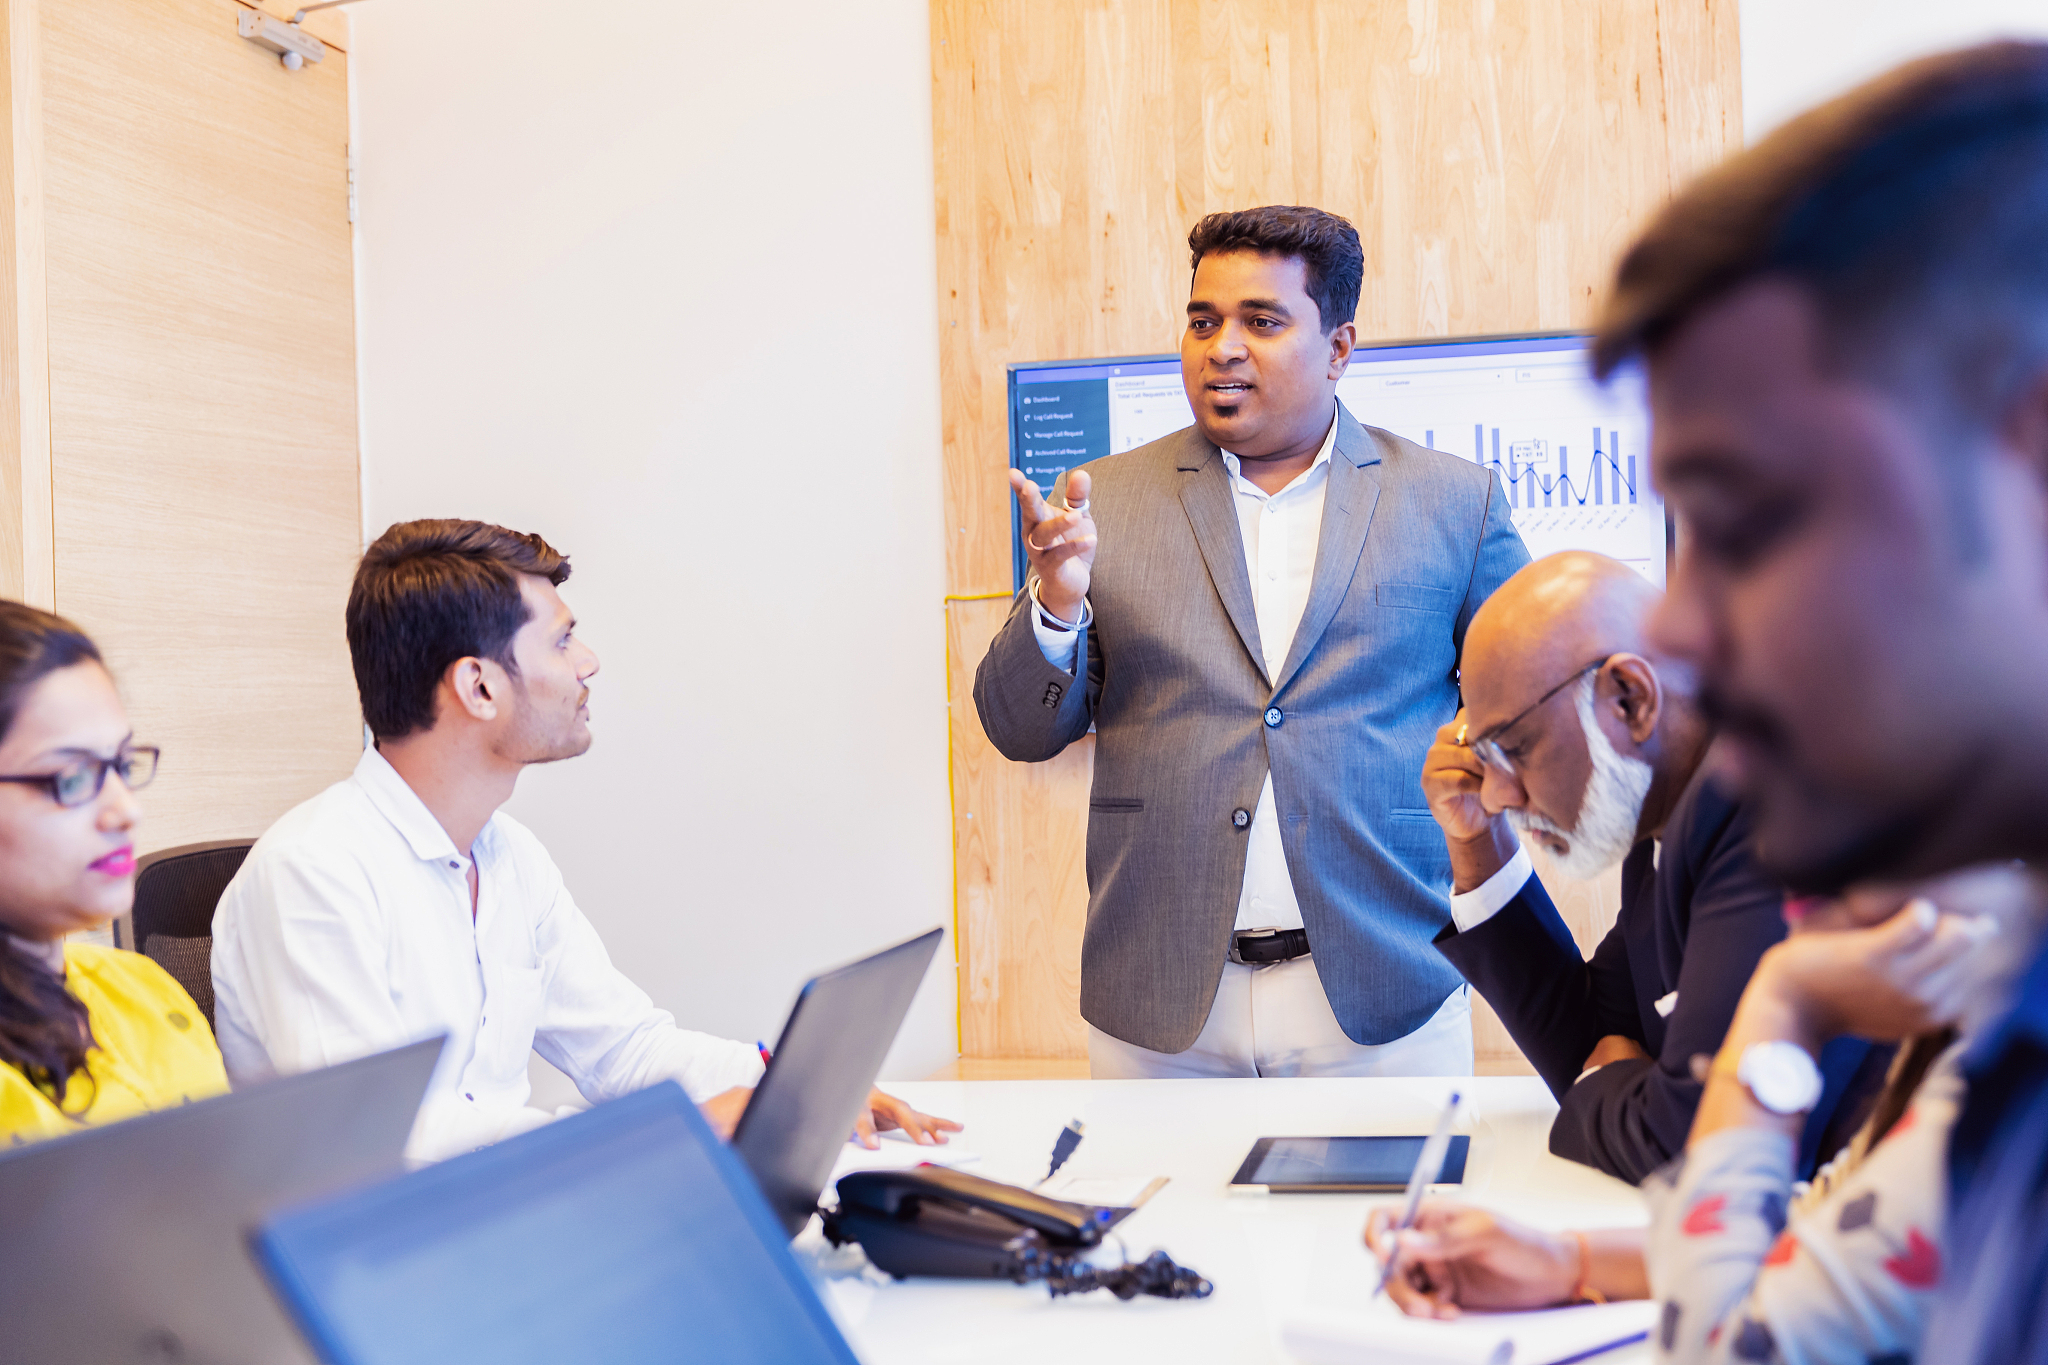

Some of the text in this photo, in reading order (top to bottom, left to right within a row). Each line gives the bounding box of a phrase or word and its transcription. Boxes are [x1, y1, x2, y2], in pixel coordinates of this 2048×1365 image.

[1115, 380, 1145, 388] Dashboard
[1033, 395, 1060, 404] Dashboard
[1142, 391, 1166, 399] Requests
[1033, 414, 1043, 422] Log
[1053, 412, 1074, 421] Request
[1053, 430, 1064, 438] Call
[1063, 429, 1084, 438] Request
[1035, 447, 1087, 457] Archived Call Request
[1035, 467, 1054, 475] Manage
